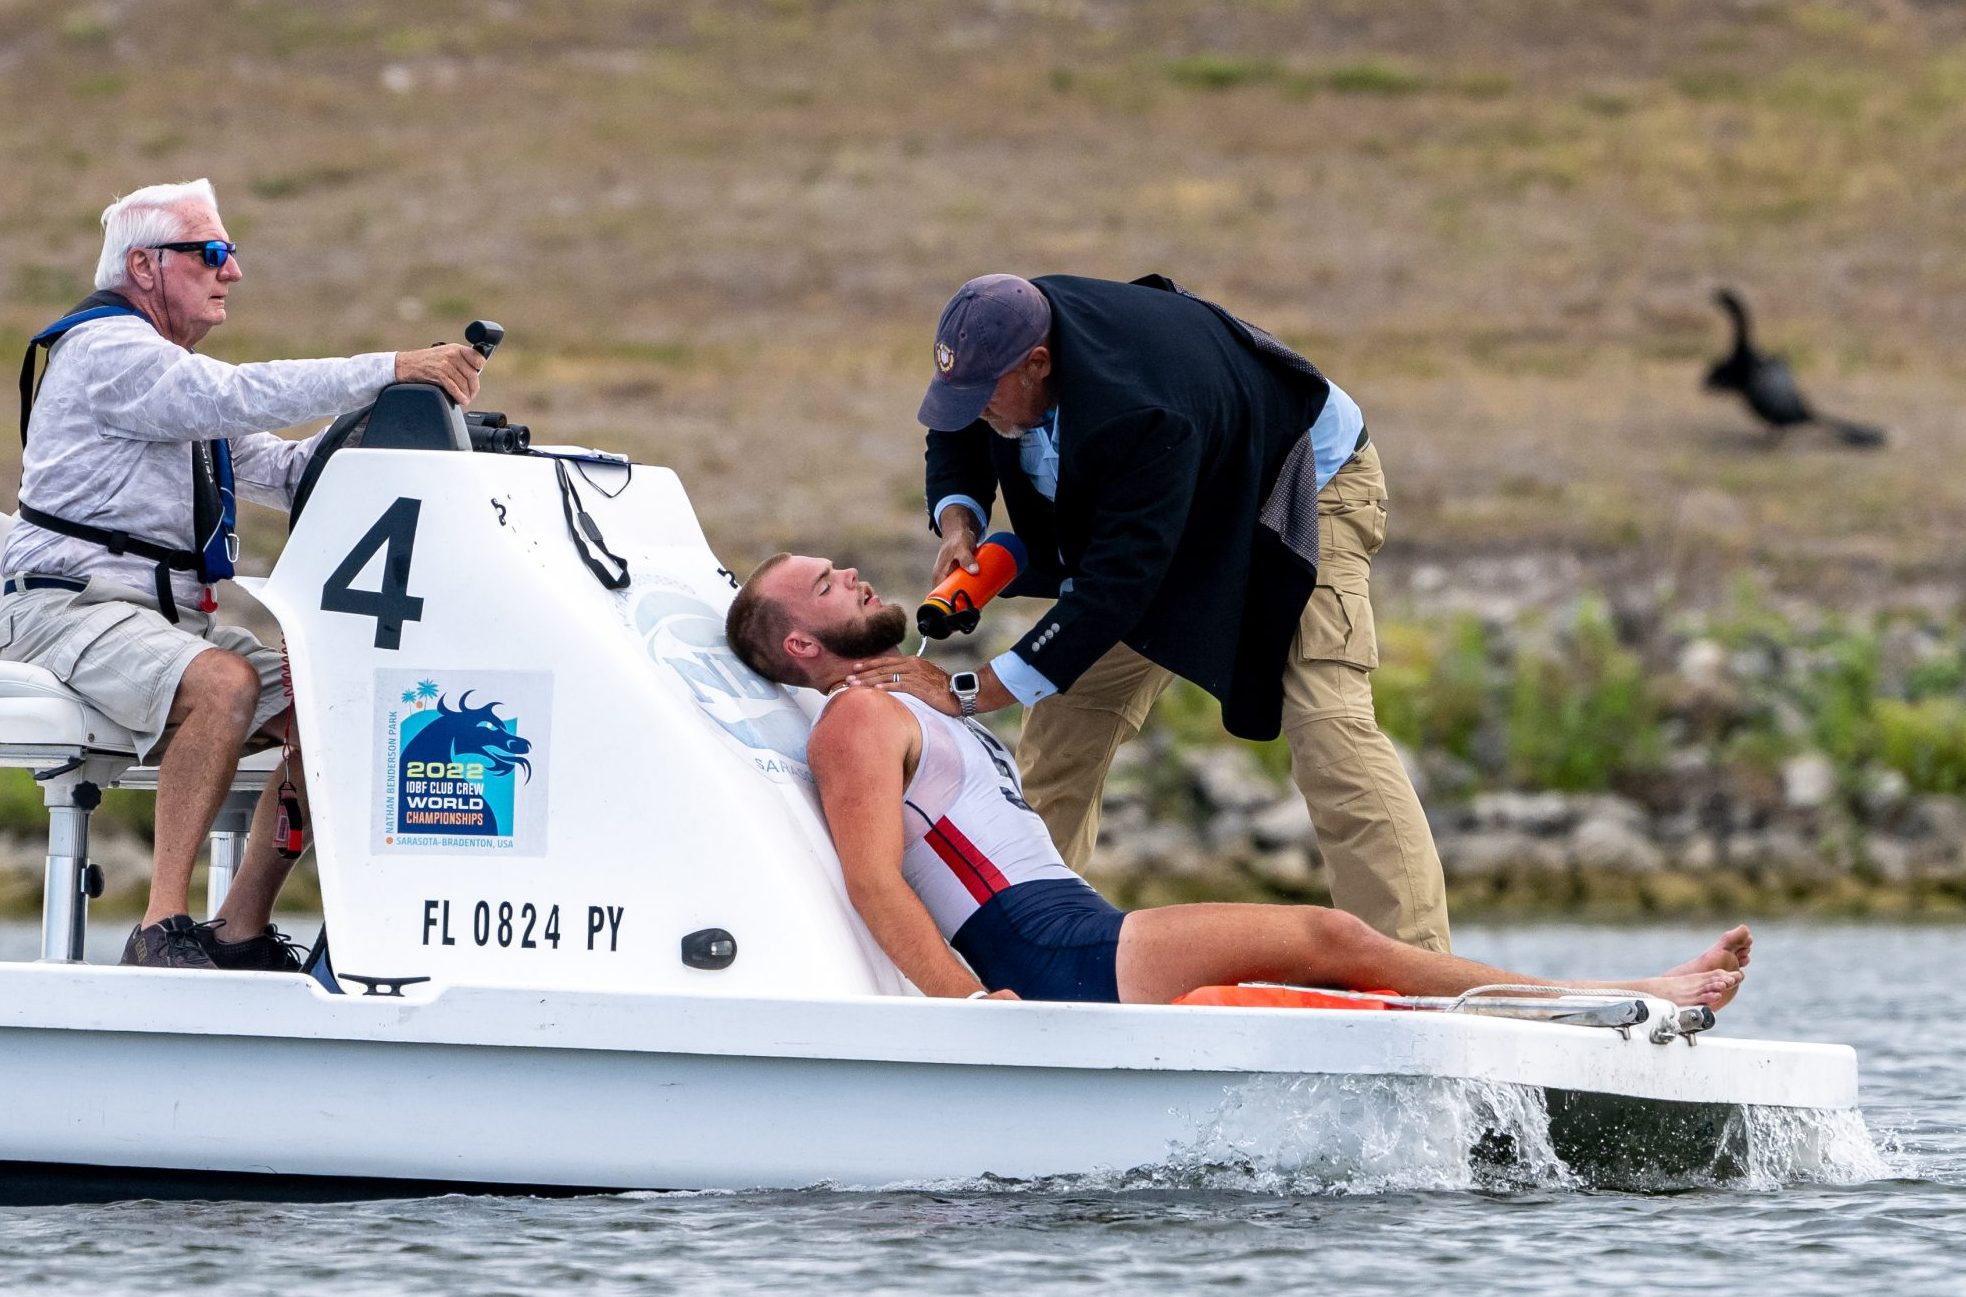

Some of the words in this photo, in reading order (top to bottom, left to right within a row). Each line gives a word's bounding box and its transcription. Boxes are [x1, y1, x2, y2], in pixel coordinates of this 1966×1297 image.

[320, 496, 424, 650] 4
[388, 711, 398, 736] PARK
[386, 740, 397, 794] BENDERSON
[406, 761, 484, 779] 2022
[406, 781, 427, 793] IDBF
[430, 781, 453, 794] CLUB
[456, 782, 484, 795] CREW
[407, 796, 484, 810] WORLD
[385, 796, 395, 834] NATHAN
[406, 811, 484, 826] CHAMPIONSHIPS
[396, 837, 496, 849] SARASOTA-BRADENTON,
[497, 840, 514, 849] USA
[422, 899, 456, 946] FL
[473, 900, 561, 949] 0824
[587, 905, 625, 952] PY
